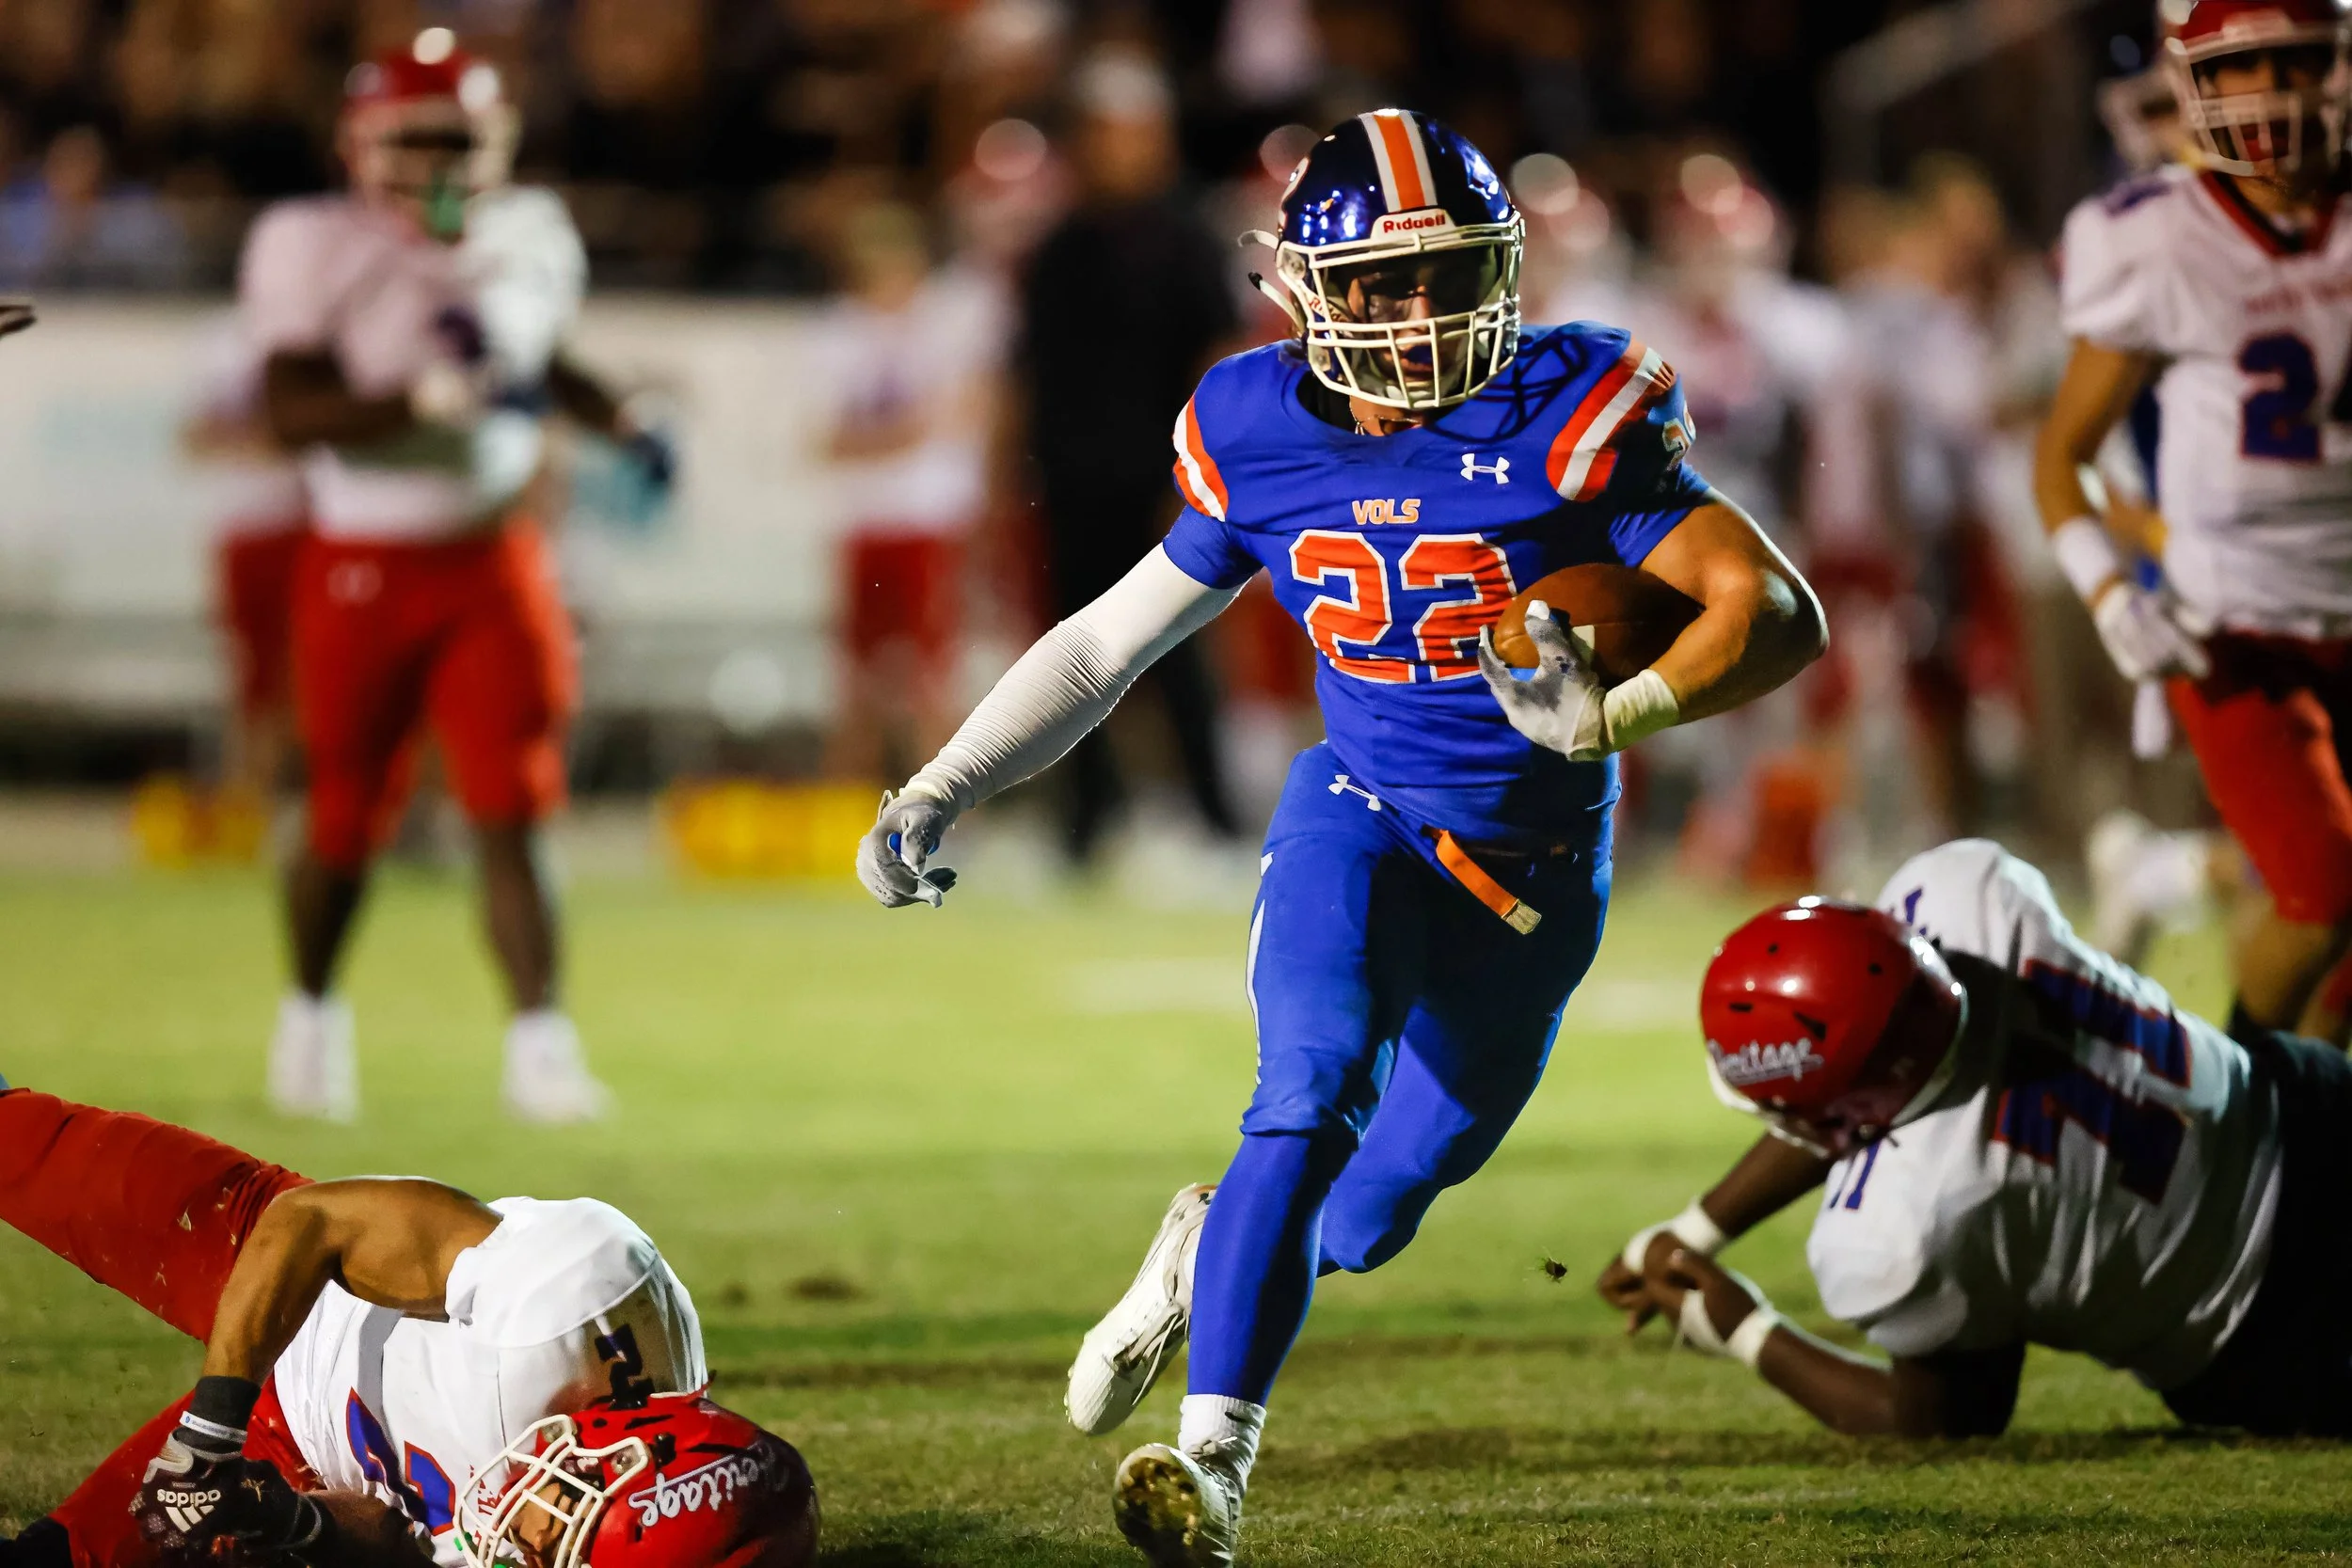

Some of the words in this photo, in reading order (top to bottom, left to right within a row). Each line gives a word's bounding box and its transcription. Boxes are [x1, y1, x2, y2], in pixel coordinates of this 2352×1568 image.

[1352, 499, 1421, 525] VOLS
[1290, 530, 1517, 684] 22
[156, 1488, 221, 1507] adidas
